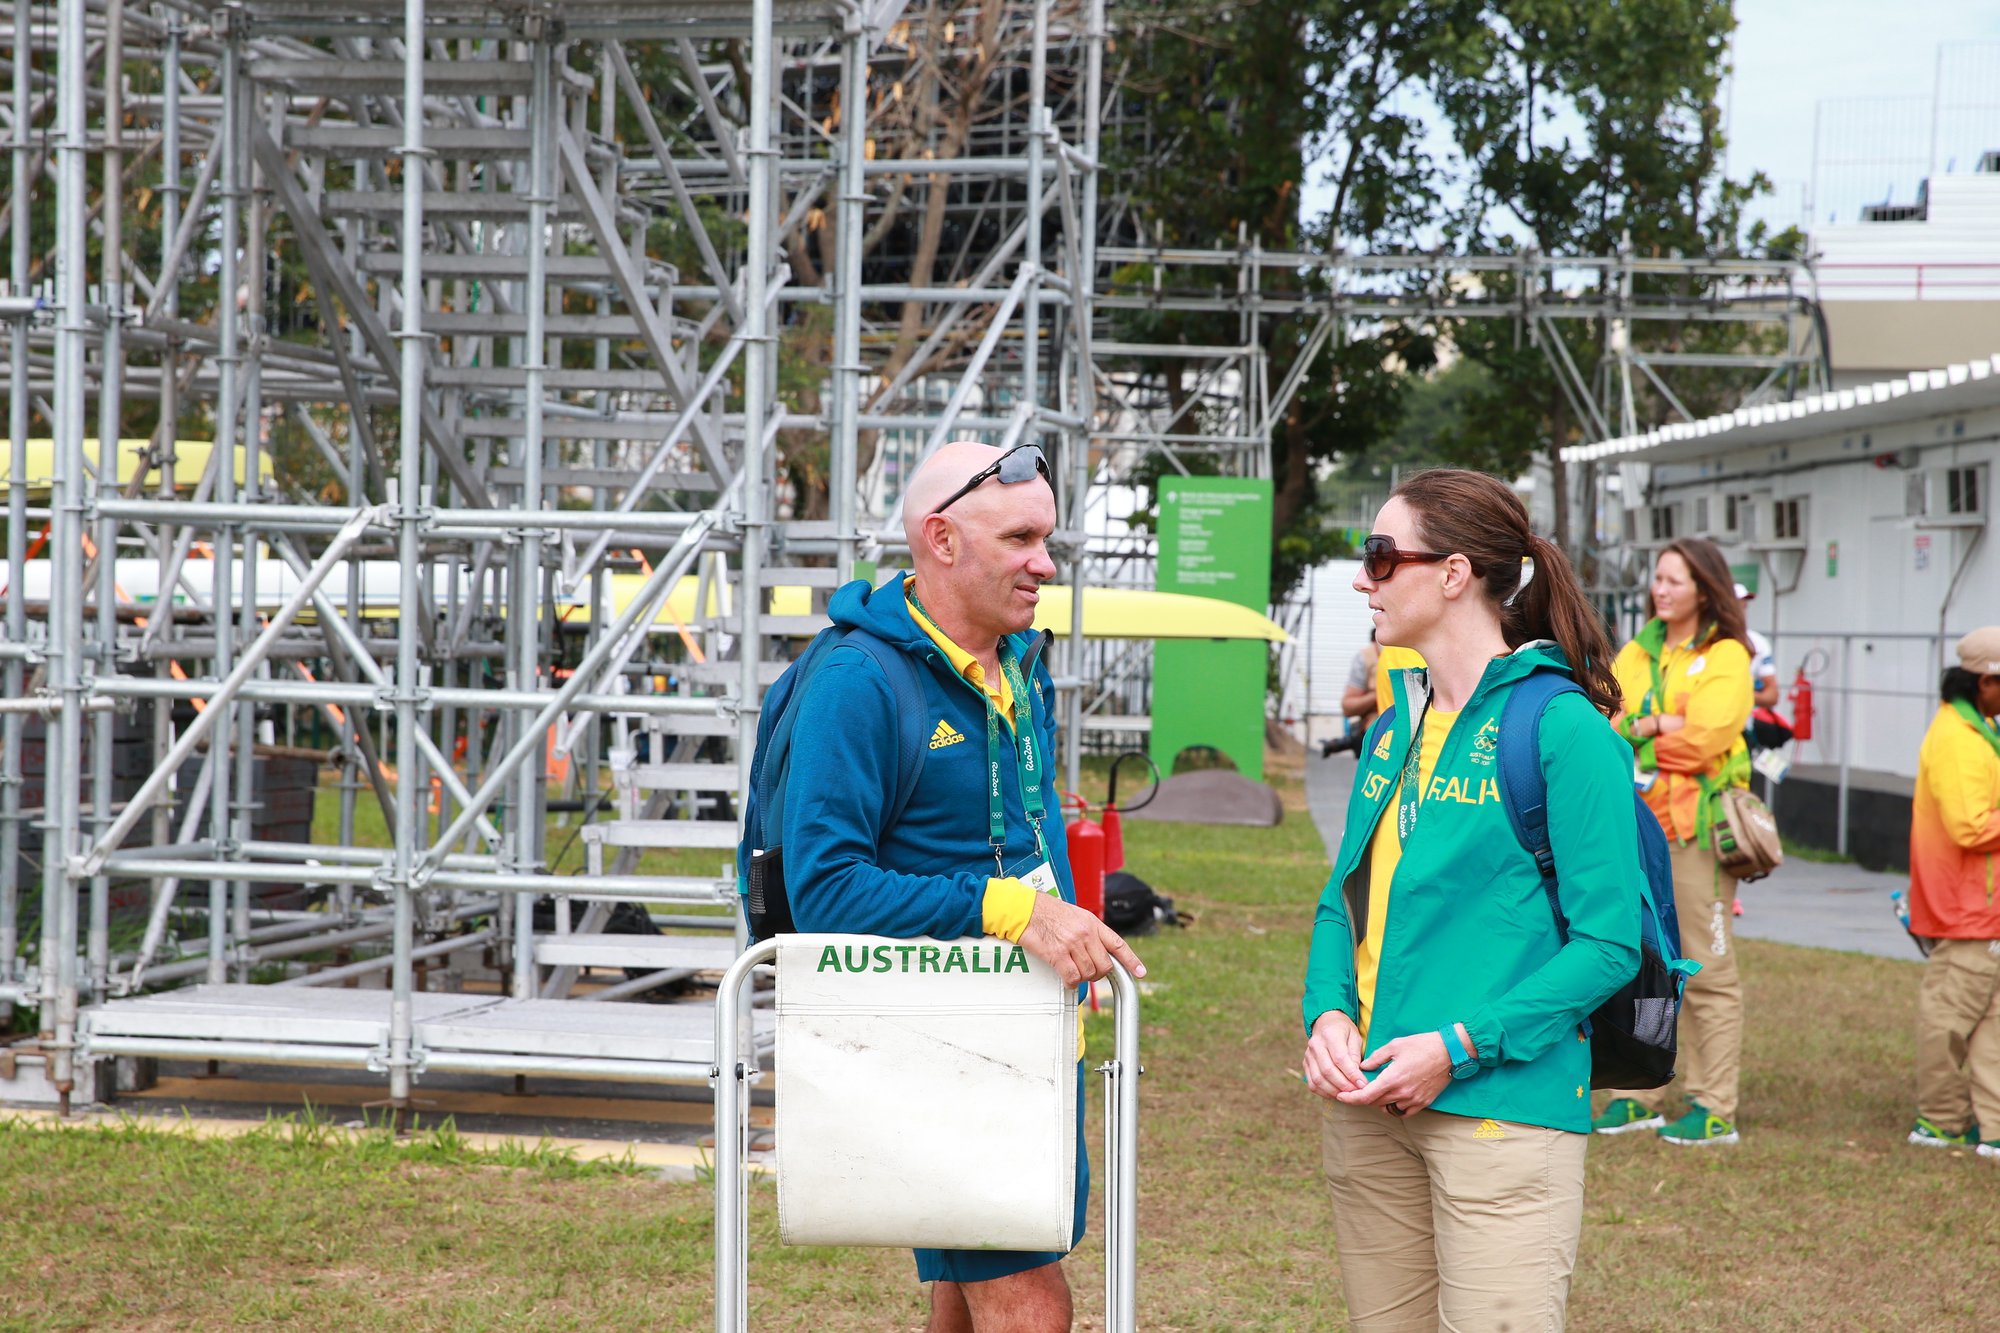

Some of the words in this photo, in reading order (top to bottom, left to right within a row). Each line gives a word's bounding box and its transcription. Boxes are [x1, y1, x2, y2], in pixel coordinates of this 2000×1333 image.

[928, 733, 965, 750] adidas
[1022, 735, 1034, 771] Rio2016
[991, 761, 999, 797] Rio2016
[816, 944, 1030, 974] AUSTRALIA
[1472, 1130, 1505, 1138] adidas
